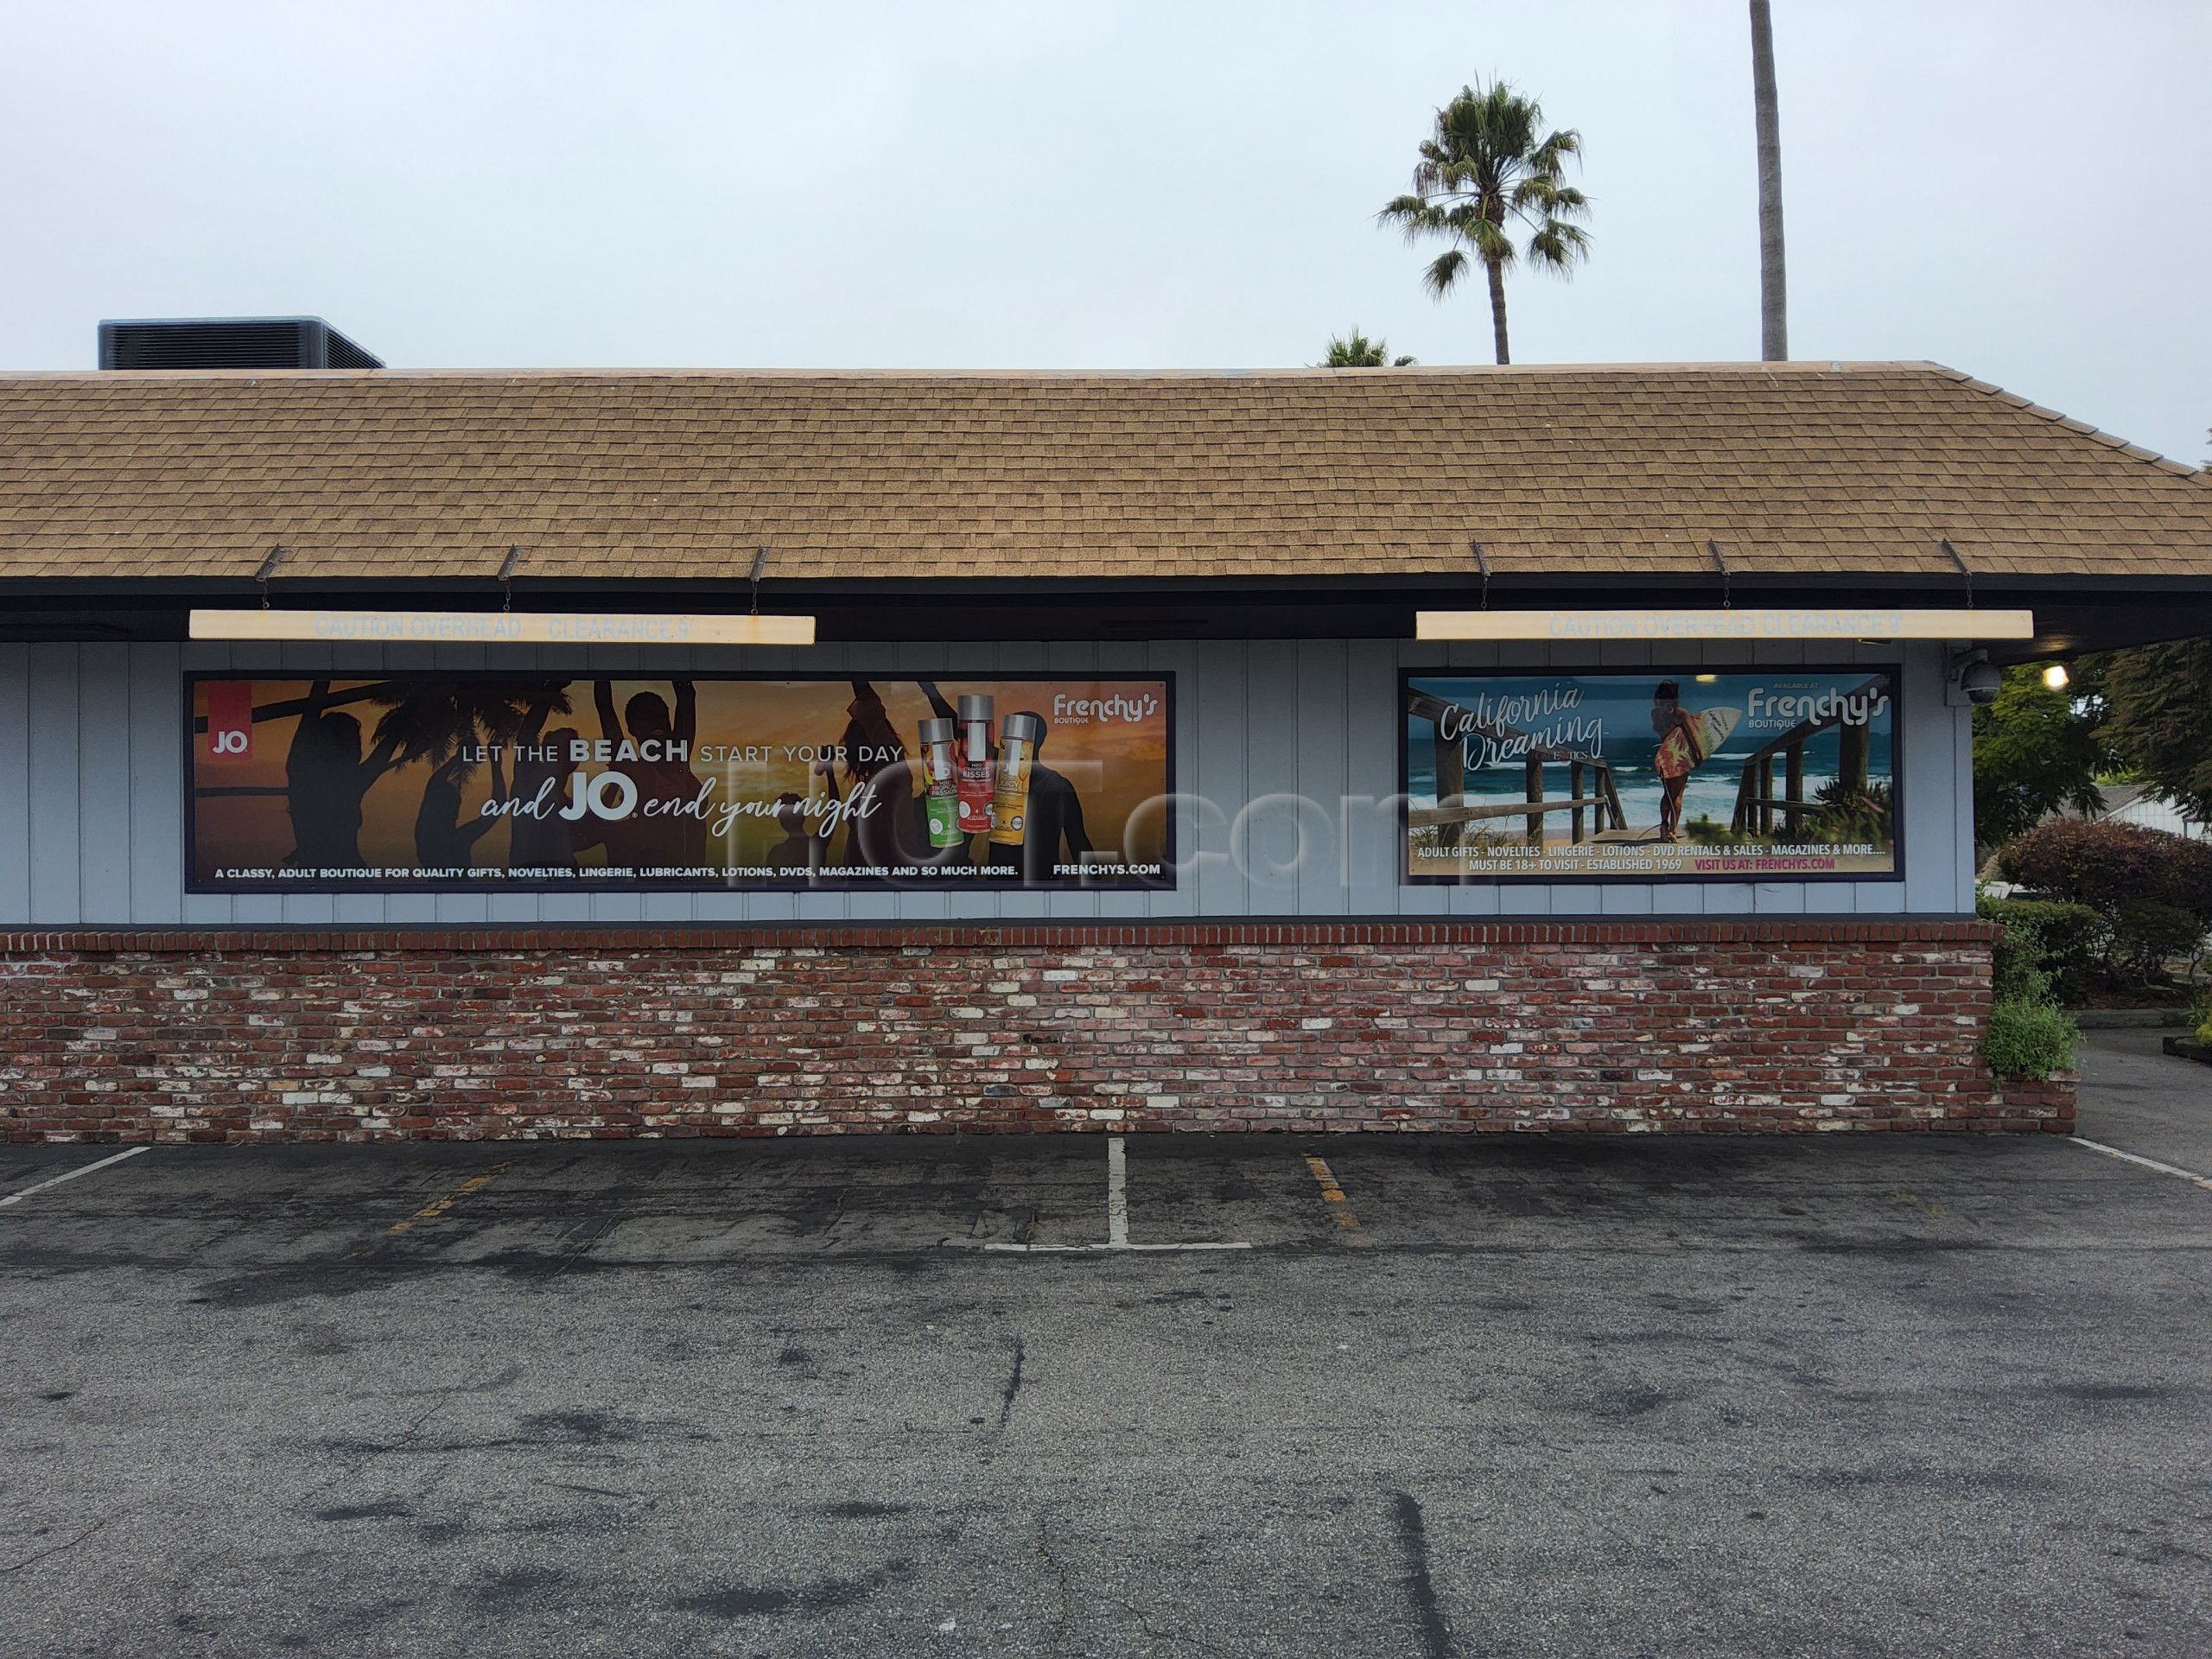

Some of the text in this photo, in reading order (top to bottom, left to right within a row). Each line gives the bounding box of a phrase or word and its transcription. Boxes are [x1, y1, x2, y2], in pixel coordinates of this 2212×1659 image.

[315, 615, 404, 637] CAUTION
[410, 616, 521, 638] OVERHEAD
[549, 618, 674, 639] CLEARANCE
[1548, 615, 1638, 637] CAUTION
[1762, 613, 1884, 635] CLEARANCE
[1053, 694, 1158, 722] Frenchy's
[1440, 683, 1584, 741] California
[1748, 687, 1889, 726] Frenchy's
[1748, 719, 1796, 730] BOUTIQUE
[212, 730, 248, 753] JO
[462, 739, 903, 762] LET THE BEACH START YOUR DAY
[1460, 716, 1603, 771] Dreaming
[480, 776, 556, 820] and
[643, 776, 716, 820] end
[711, 800, 786, 837] your
[792, 781, 882, 838] night
[1418, 847, 1449, 857] ADULT
[1452, 847, 1479, 857] GIFTS
[1487, 846, 1541, 857] NOVELTIES
[1548, 846, 1594, 856] LINGERIE
[1603, 846, 1645, 856] LOTIONS
[1653, 846, 1675, 856] DVD
[1679, 846, 1720, 856] RENTALS
[1723, 845, 1732, 855] &
[1733, 845, 1764, 855] SALES
[1771, 845, 1830, 855] MAGAZINES
[1833, 845, 1840, 855] &
[215, 866, 1019, 880] A CLASSY, ADULT BOUTIQUE FOR QUALITY GIFTS, NOVELTIES, LINGERIE, LUBRICANTS, LOTIONS, DVDS, MAGAZINES AND SO MUCH MORE.
[1052, 864, 1160, 875] FRENCHYS.COM
[1470, 860, 1498, 871] MUST
[1500, 860, 1513, 870] BE
[1516, 860, 1537, 870] 18+
[1539, 860, 1552, 870] TO
[1554, 860, 1580, 870] VISIT
[1586, 859, 1653, 870] ESTABLISHED
[1656, 859, 1682, 870] 1969
[1694, 858, 1835, 870] VISIT US AT: FRENCHYS.COM
